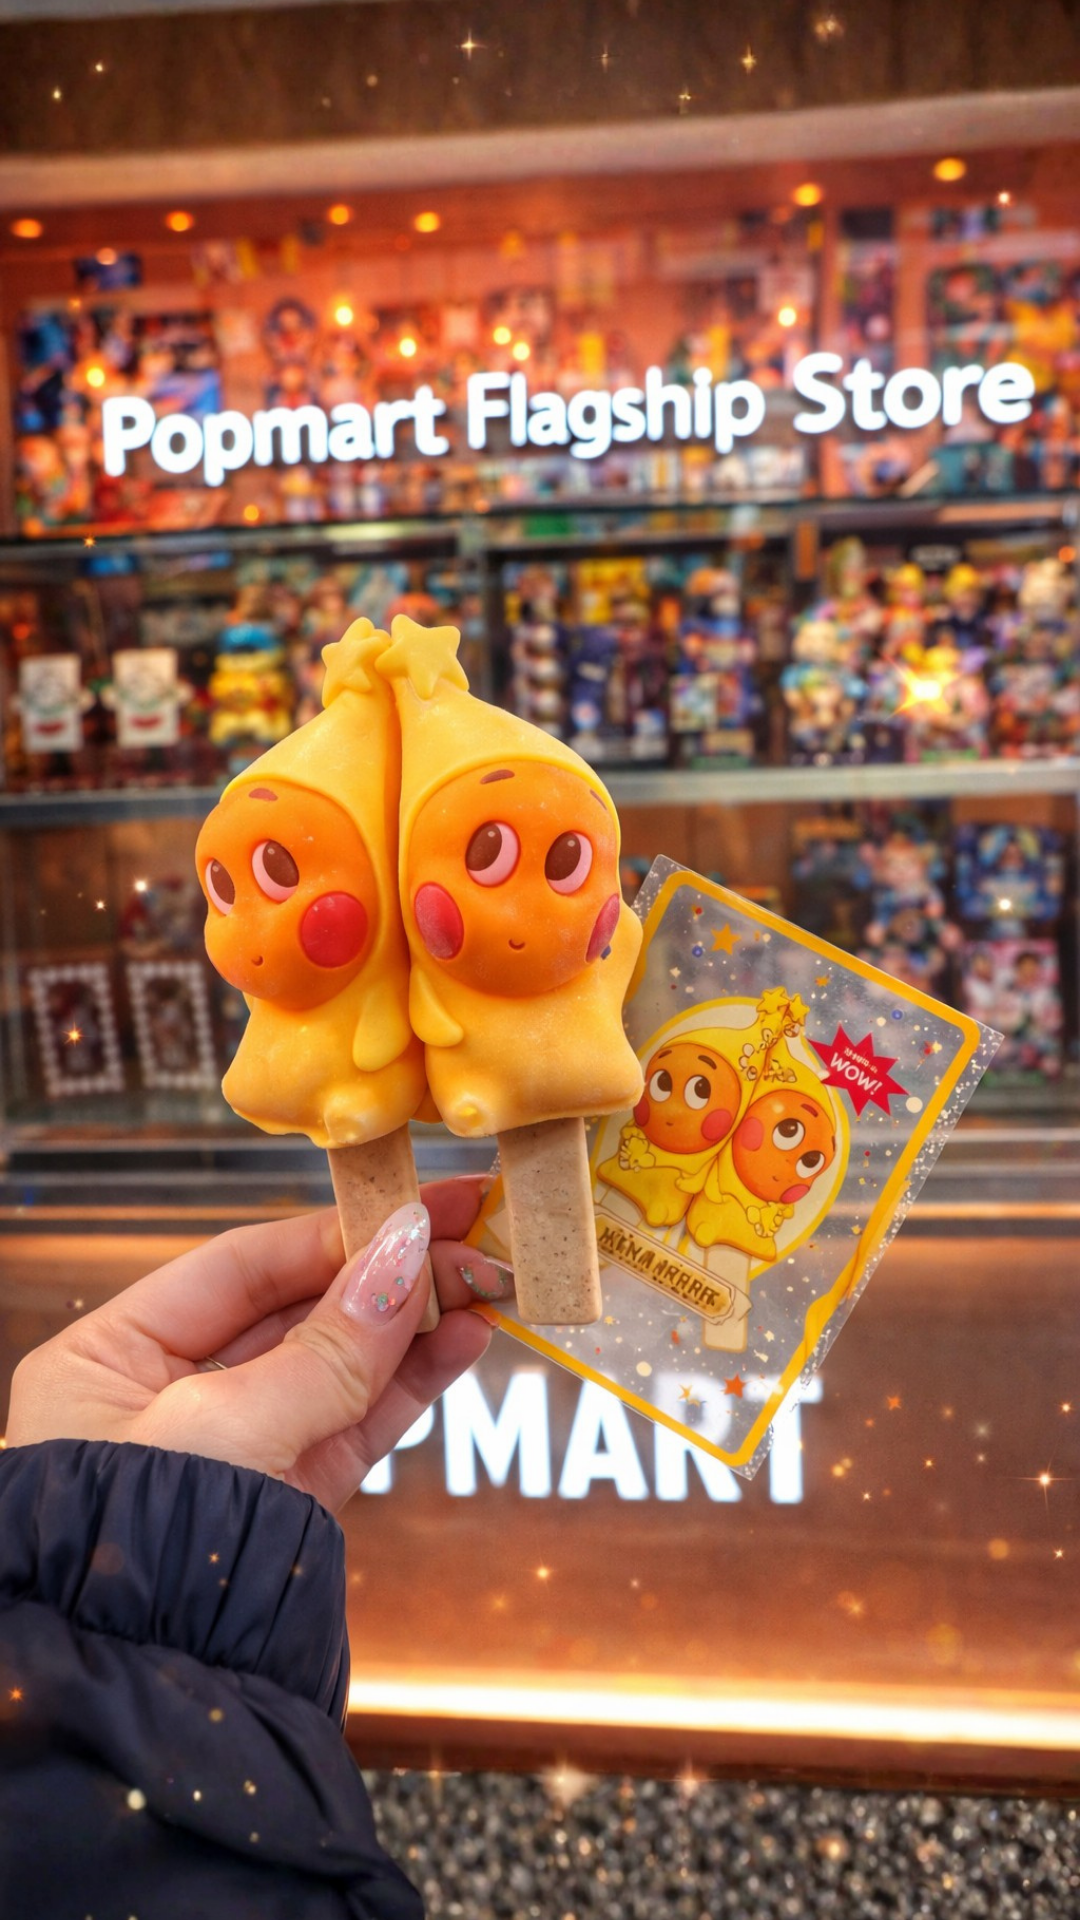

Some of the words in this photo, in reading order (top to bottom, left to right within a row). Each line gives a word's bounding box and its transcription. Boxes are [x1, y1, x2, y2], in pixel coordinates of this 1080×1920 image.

[101, 385, 450, 487] Popmart
[466, 365, 766, 460] Flagship
[792, 351, 1036, 434] Store
[830, 1052, 883, 1096] WOW!
